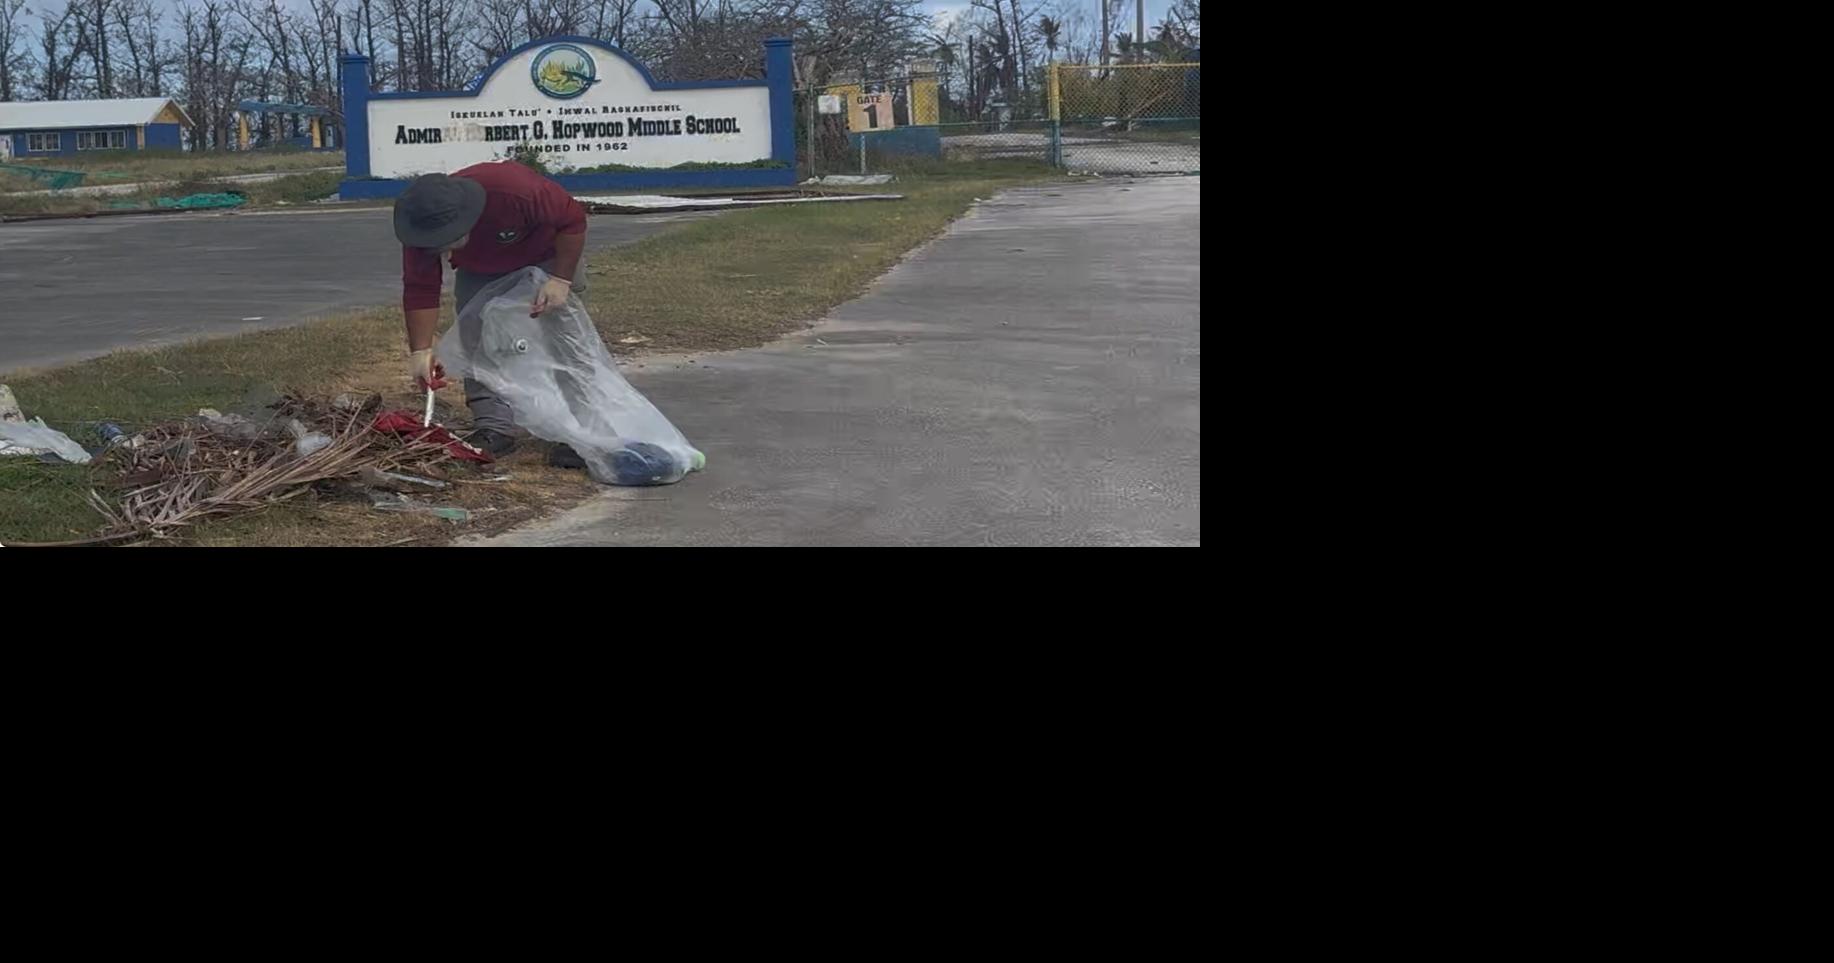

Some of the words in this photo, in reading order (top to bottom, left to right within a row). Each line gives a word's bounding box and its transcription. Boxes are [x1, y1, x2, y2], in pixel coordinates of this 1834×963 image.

[857, 96, 882, 105] GATE
[863, 104, 878, 128] 1
[552, 119, 624, 139] HOPWOOD
[628, 117, 682, 137] MIDDLE
[685, 115, 741, 135] SCHOOL
[576, 143, 591, 152] IN
[596, 142, 629, 151] 1962
